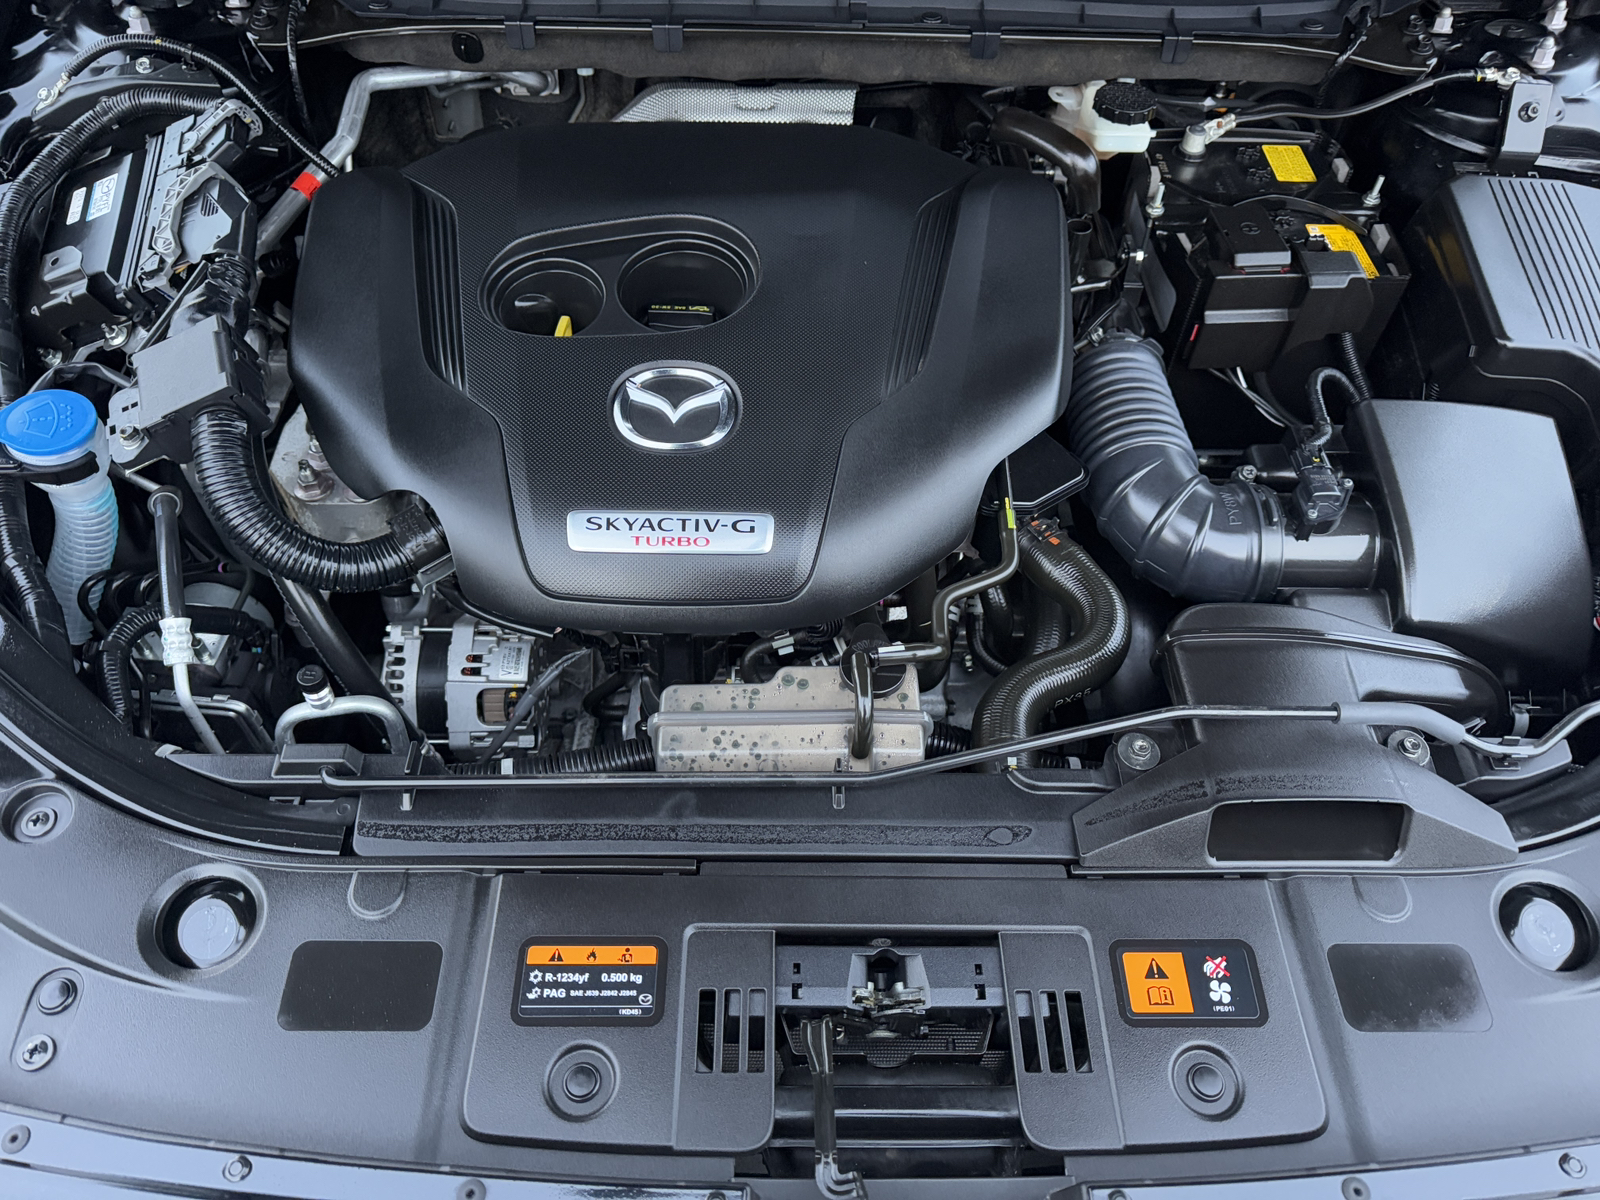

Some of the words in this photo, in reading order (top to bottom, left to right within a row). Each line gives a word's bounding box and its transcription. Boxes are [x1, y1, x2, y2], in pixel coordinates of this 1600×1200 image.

[585, 516, 756, 533] SKYACTIV-G
[631, 535, 710, 547] TURBO
[544, 972, 590, 984] R-1234yf
[601, 972, 629, 983] 0.500
[629, 972, 643, 984] kg
[543, 988, 566, 998] PAG
[569, 989, 583, 997] SAE
